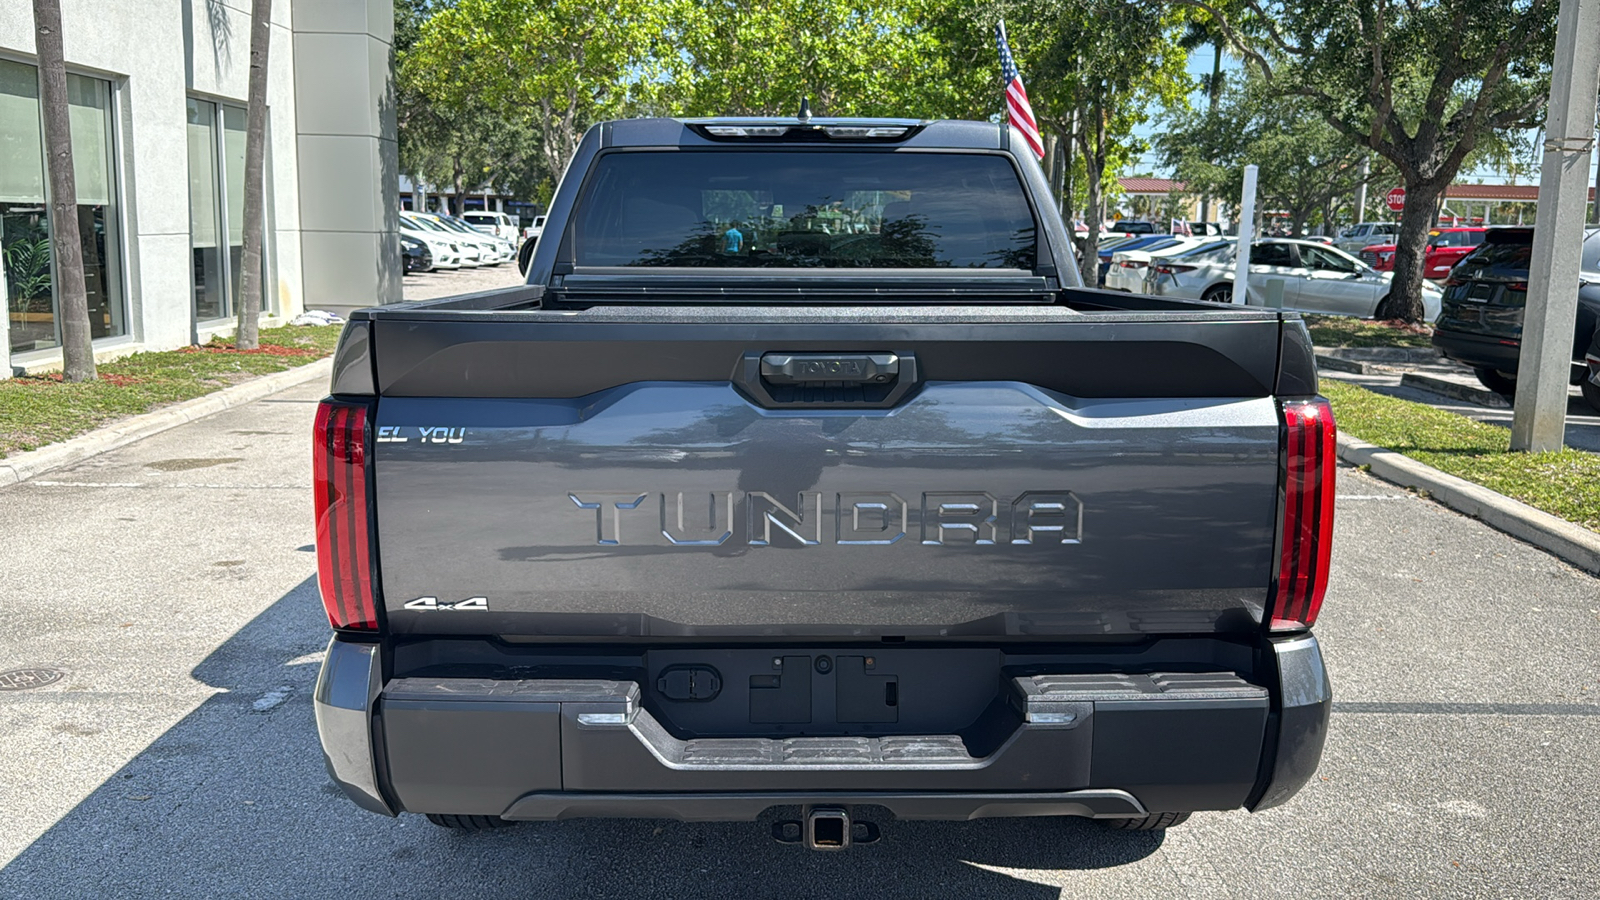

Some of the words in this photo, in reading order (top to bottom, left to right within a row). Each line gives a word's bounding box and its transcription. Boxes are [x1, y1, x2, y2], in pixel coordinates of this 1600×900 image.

[799, 361, 861, 374] TOYOTA
[376, 426, 408, 443] EL
[418, 426, 466, 444] YOU
[567, 490, 1084, 546] TUNDRA
